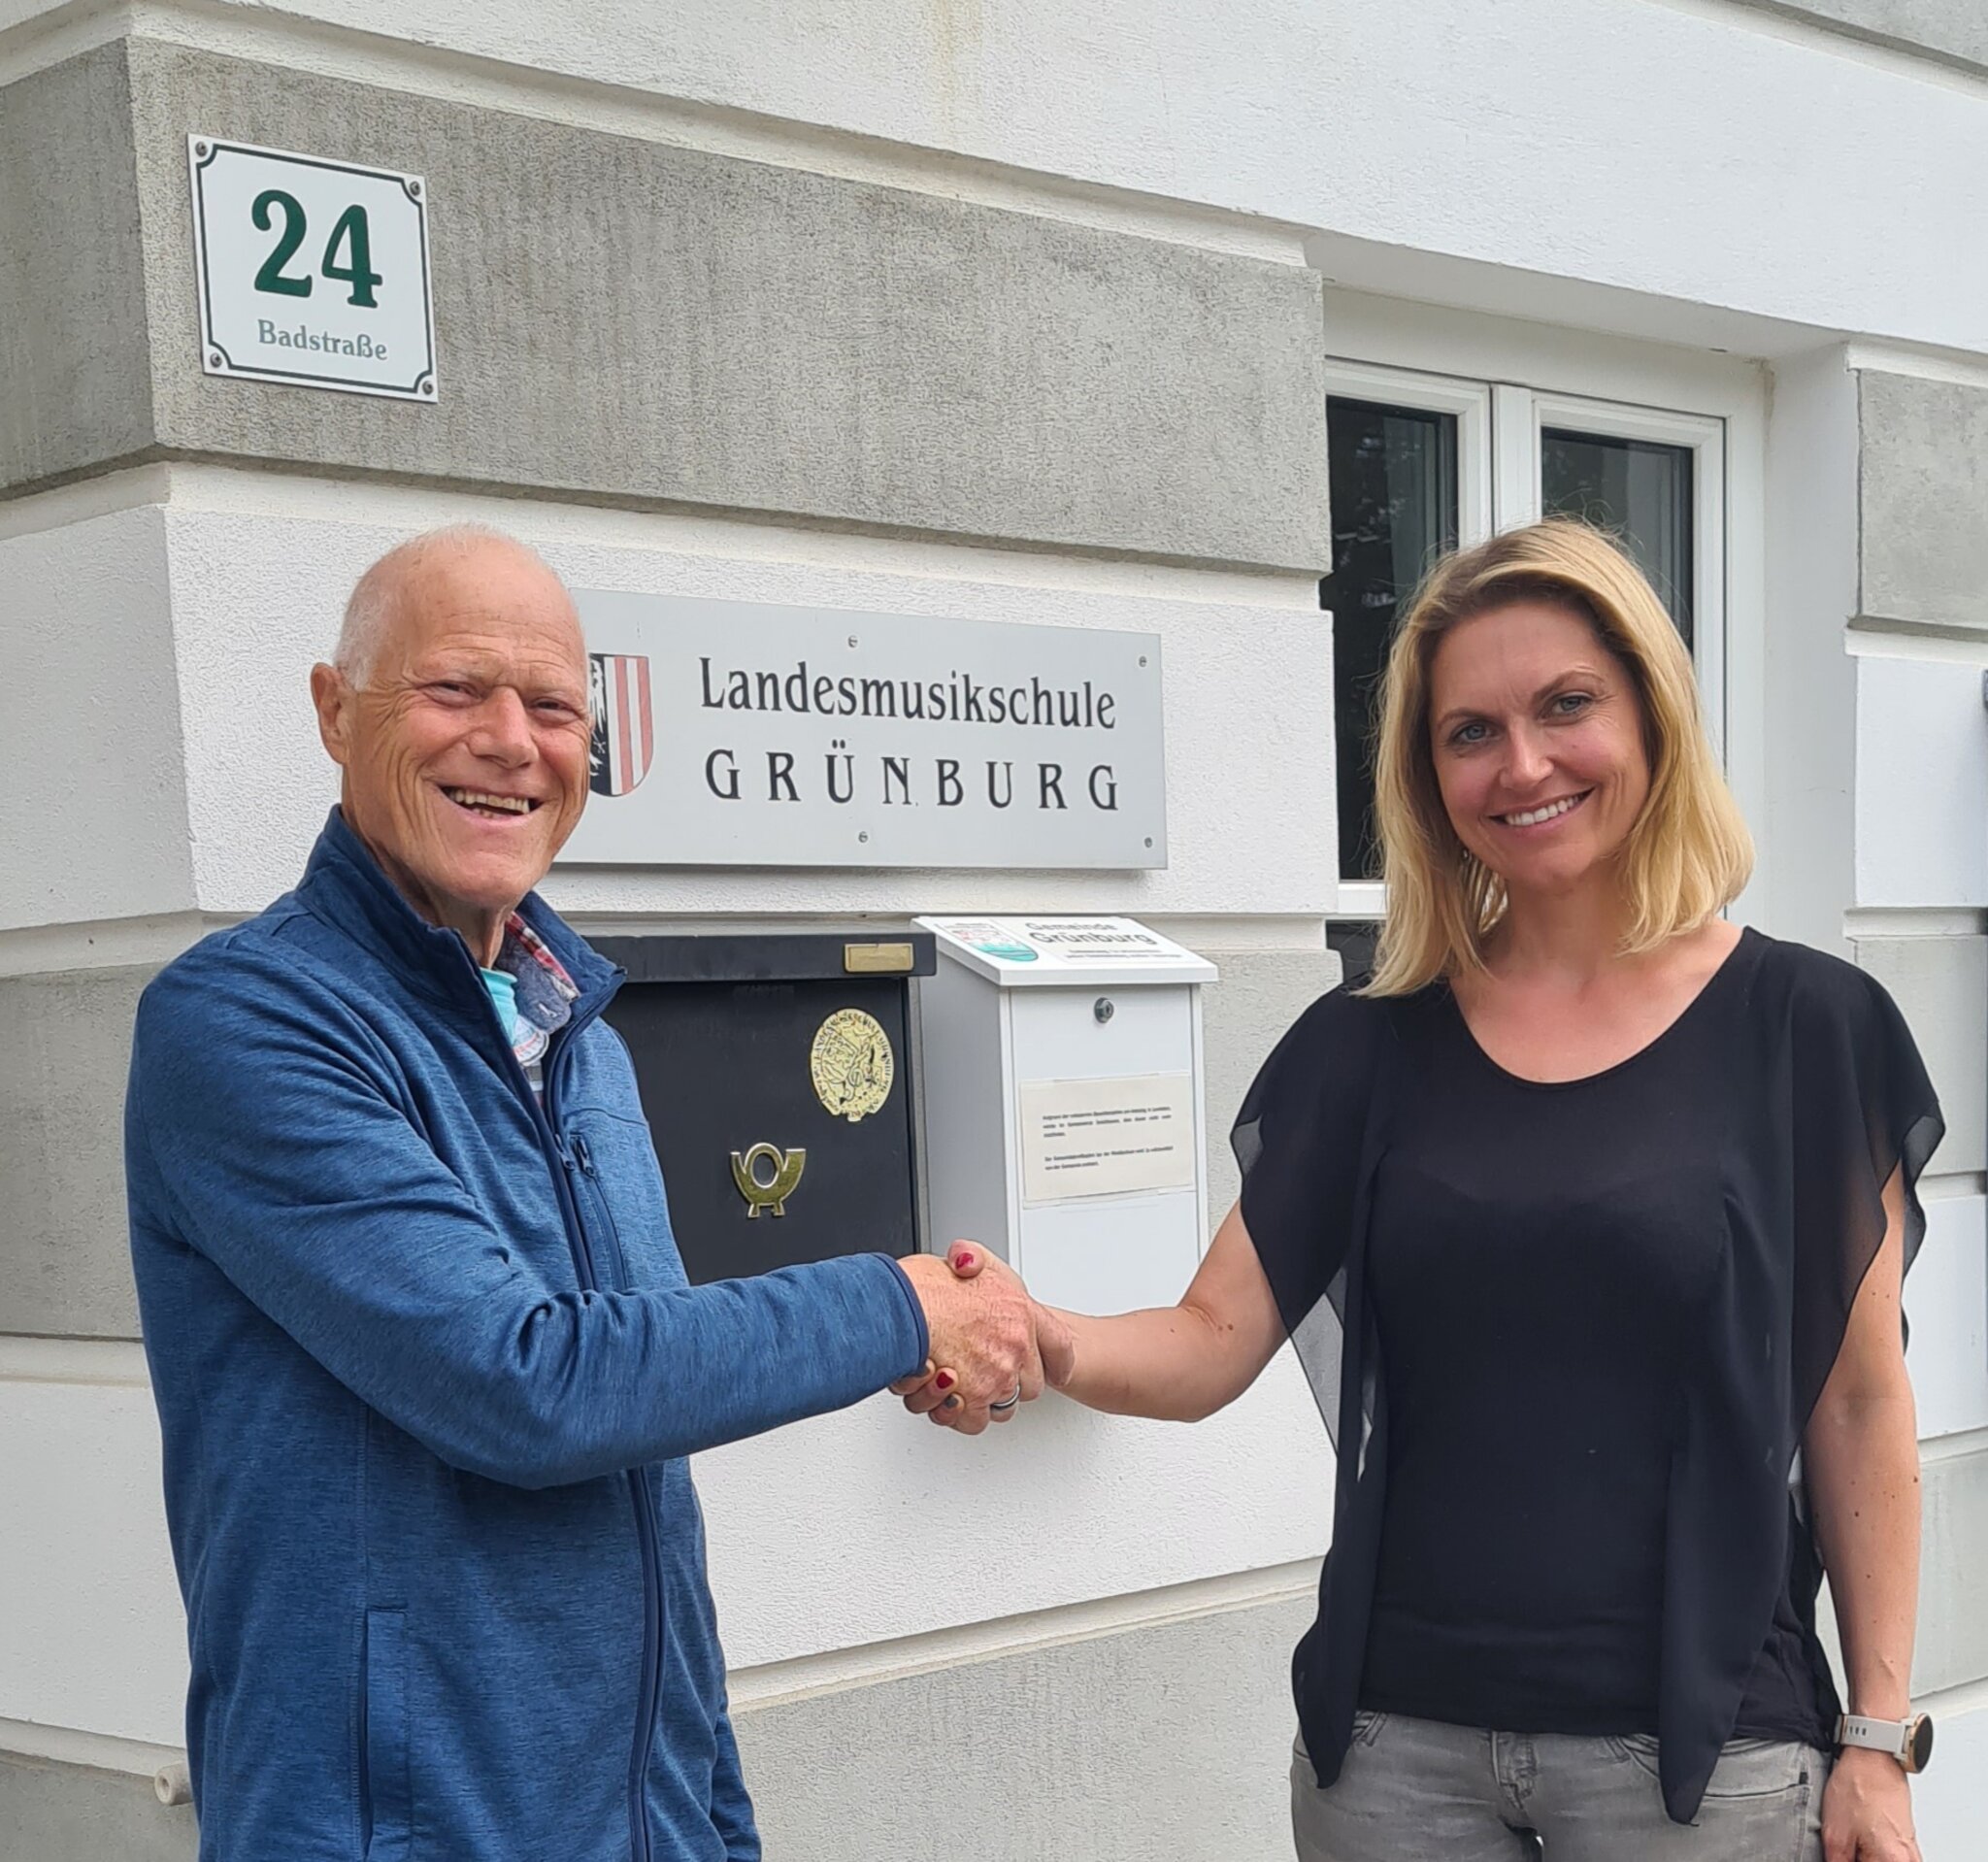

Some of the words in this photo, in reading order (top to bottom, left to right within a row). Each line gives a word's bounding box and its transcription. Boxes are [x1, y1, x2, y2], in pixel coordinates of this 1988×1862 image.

[251, 189, 382, 309] 24
[257, 318, 388, 360] Badstraße
[699, 656, 1116, 729] Landesmusikschule
[705, 739, 1119, 811] GRÜNBURG
[1029, 932, 1157, 945] Grünburg
